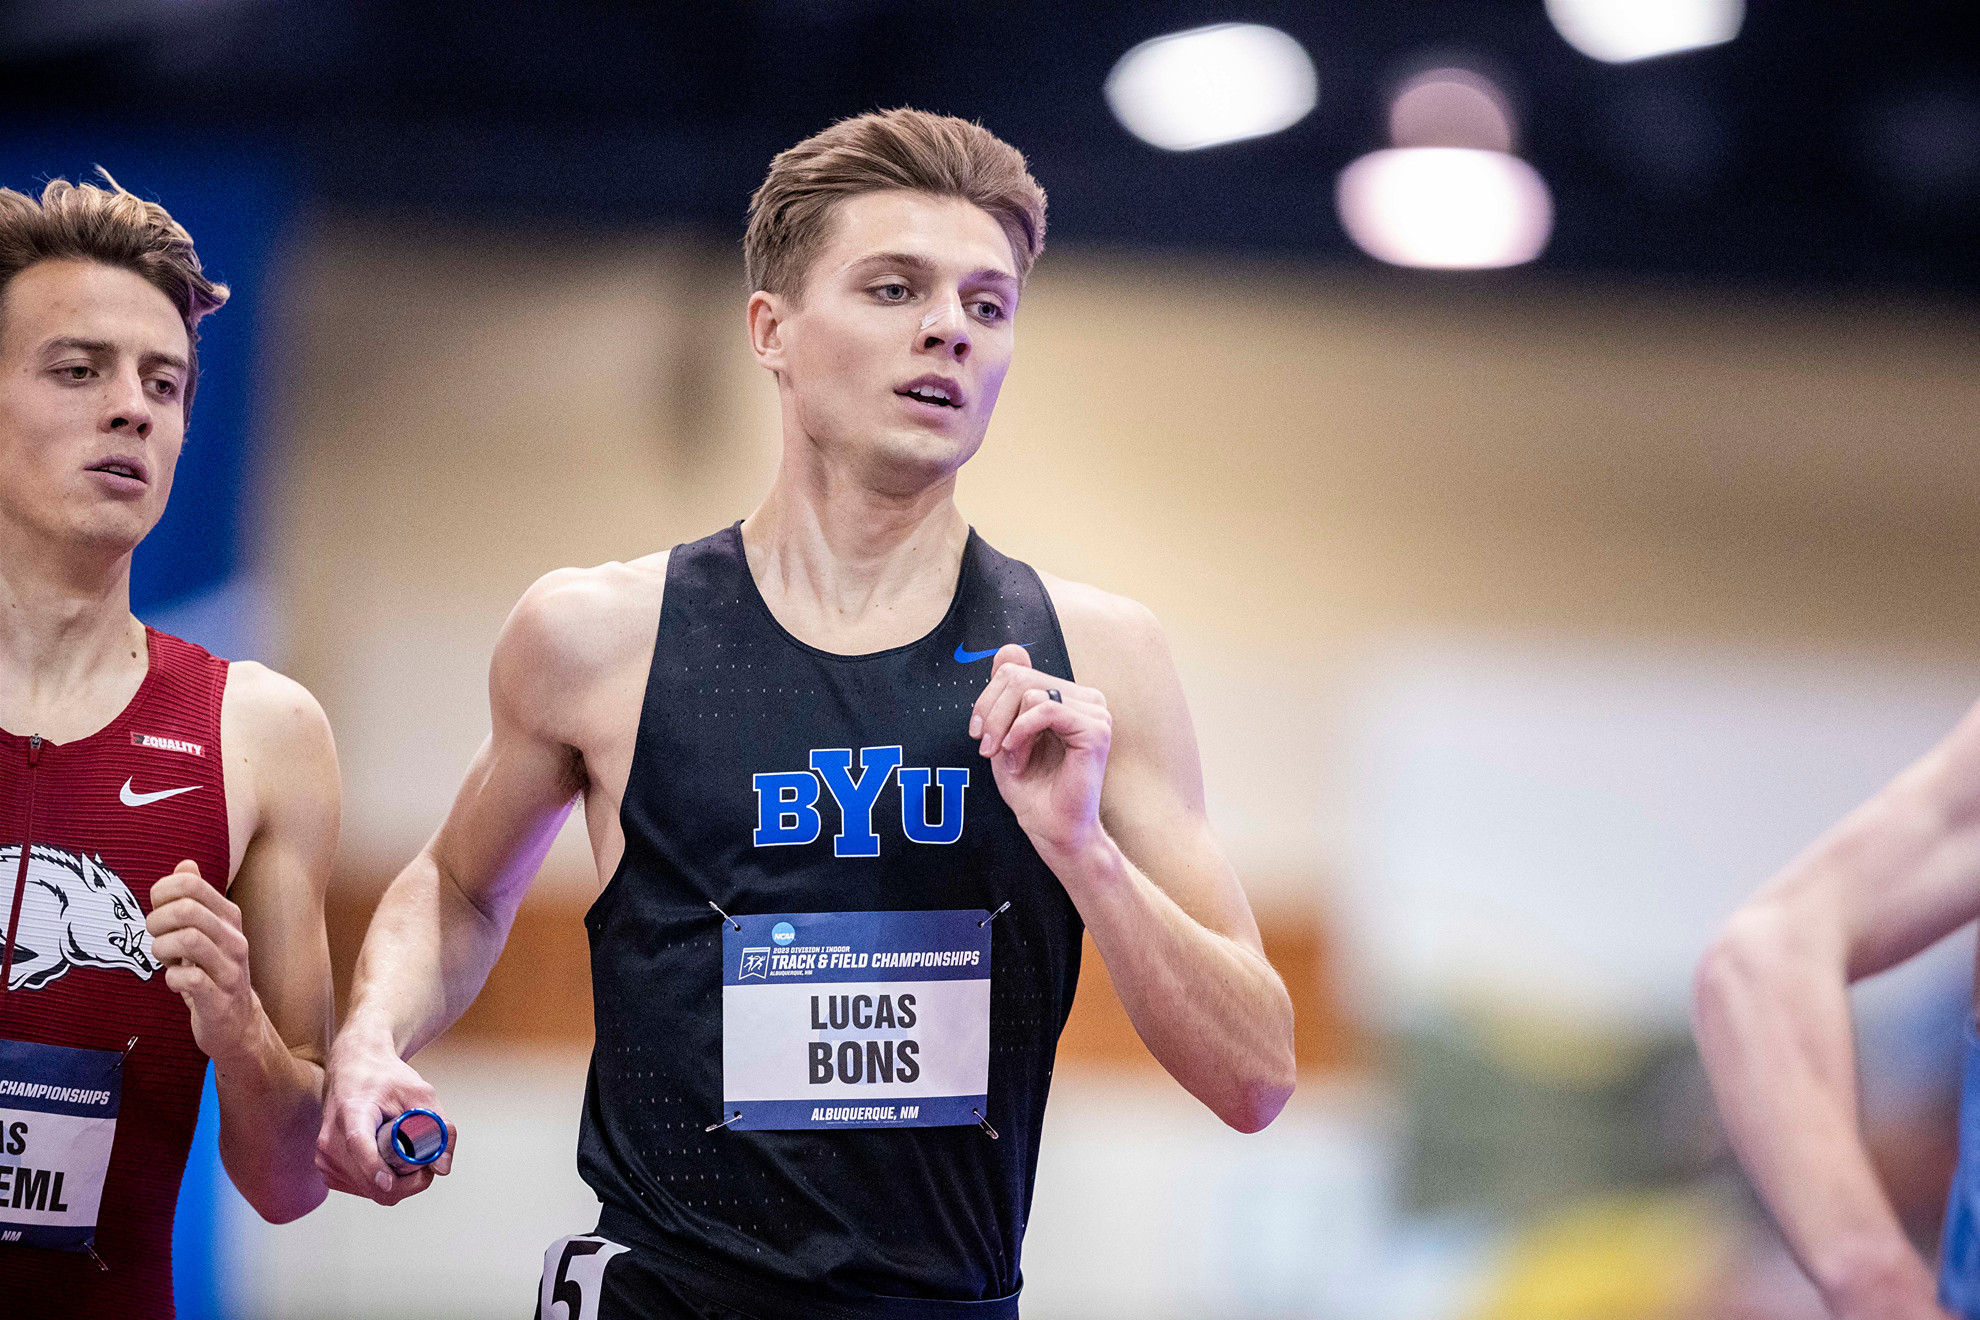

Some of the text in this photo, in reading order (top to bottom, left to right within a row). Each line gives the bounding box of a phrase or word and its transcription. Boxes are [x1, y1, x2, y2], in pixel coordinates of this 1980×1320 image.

[142, 735, 202, 755] EQUALITY
[753, 745, 970, 857] BYU
[771, 951, 980, 970] TRACK & FIELD CHAMPIONSHIPS
[810, 994, 917, 1030] LUCAS
[808, 1040, 920, 1085] BONS
[0, 1080, 110, 1105] CHAMPIONSHIPS
[811, 1106, 919, 1121] ALBUQUERQUE, NM
[0, 1120, 28, 1155] S
[1, 1230, 22, 1241] NM
[551, 1240, 607, 1320] 5
